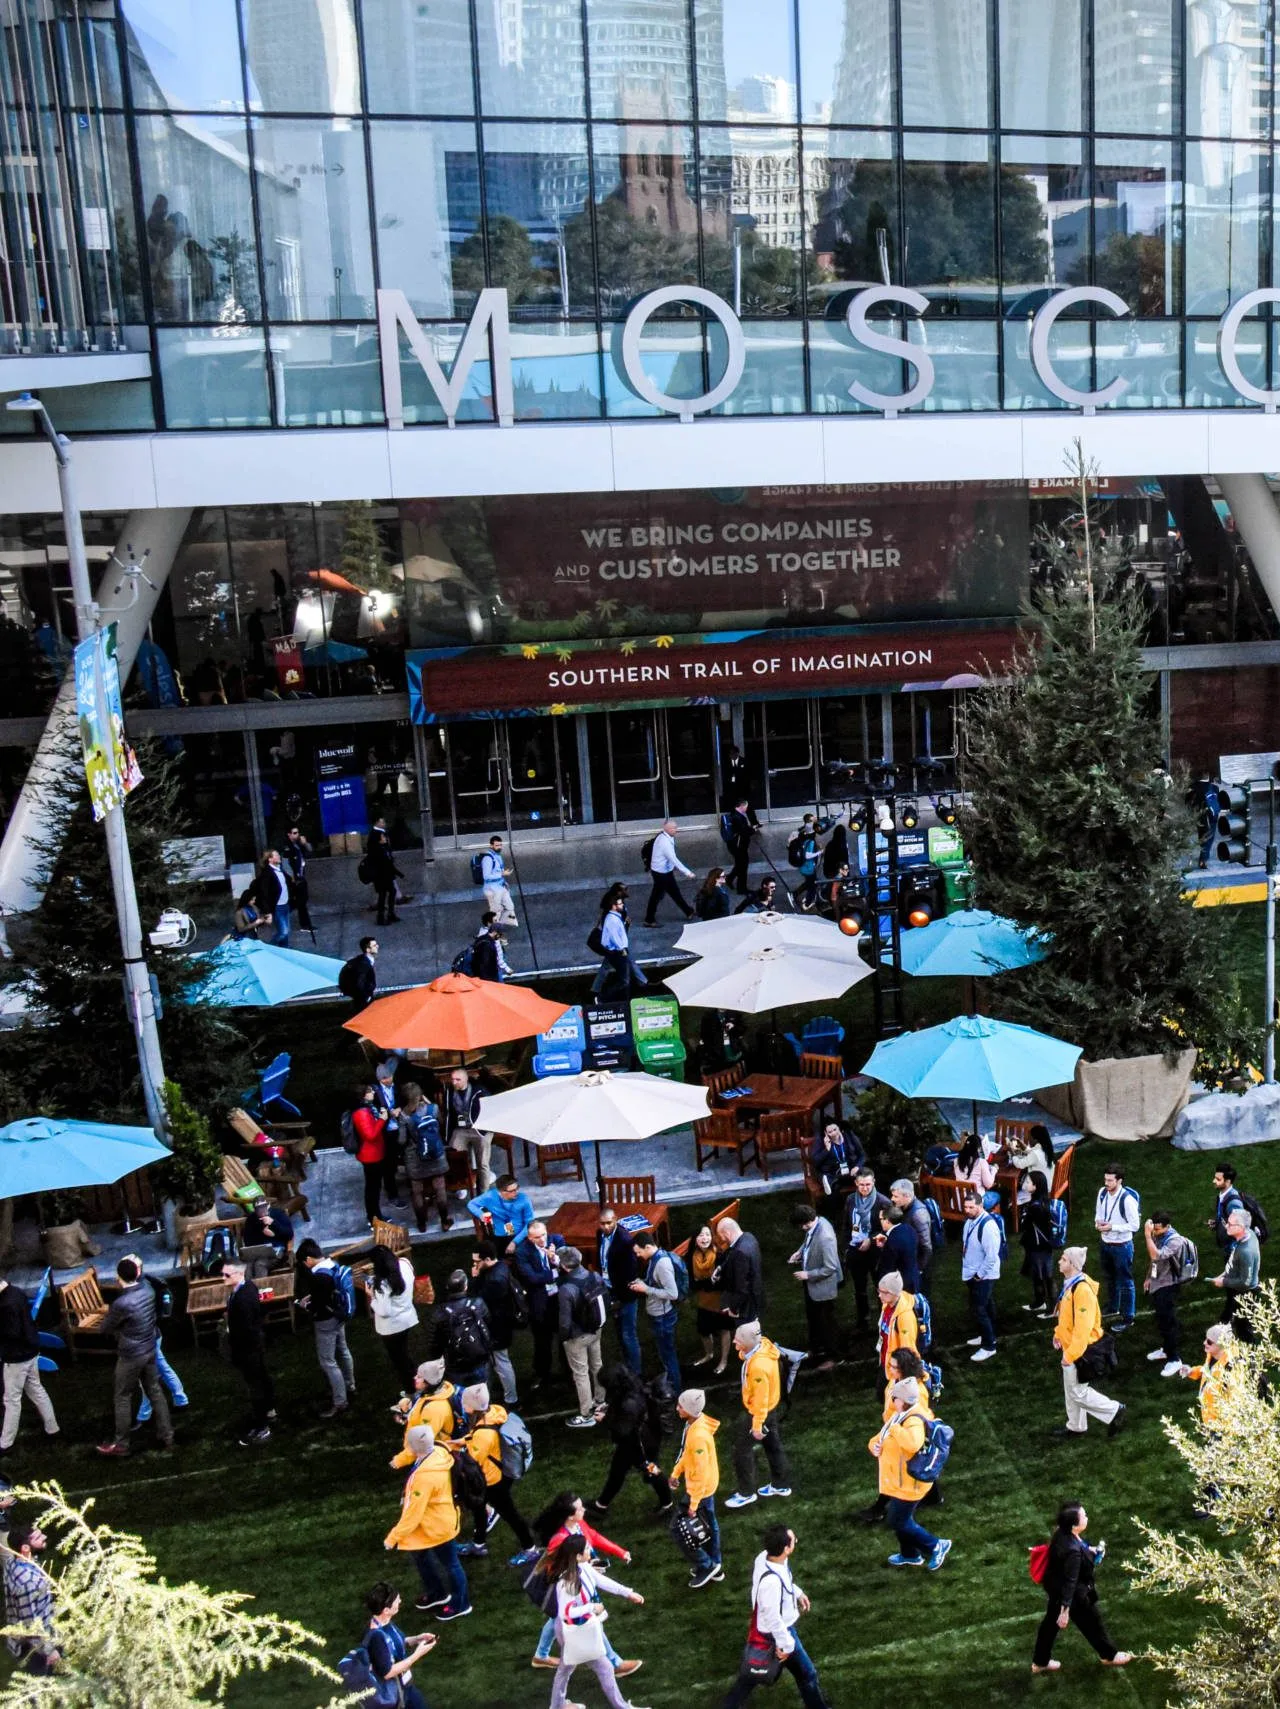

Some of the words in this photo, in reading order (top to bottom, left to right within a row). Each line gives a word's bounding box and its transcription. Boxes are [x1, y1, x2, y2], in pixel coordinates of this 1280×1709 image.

[581, 527, 622, 549] WE
[631, 524, 713, 546] BRING
[722, 518, 873, 544] COMPANIES
[554, 564, 590, 577] AND
[599, 555, 759, 581] CUSTOMERS
[767, 547, 901, 573] TOGETHER
[548, 665, 670, 687] SOUTHERN
[680, 660, 743, 679] TRAIL
[752, 658, 781, 675] OF
[791, 649, 932, 672] IMAGINATION
